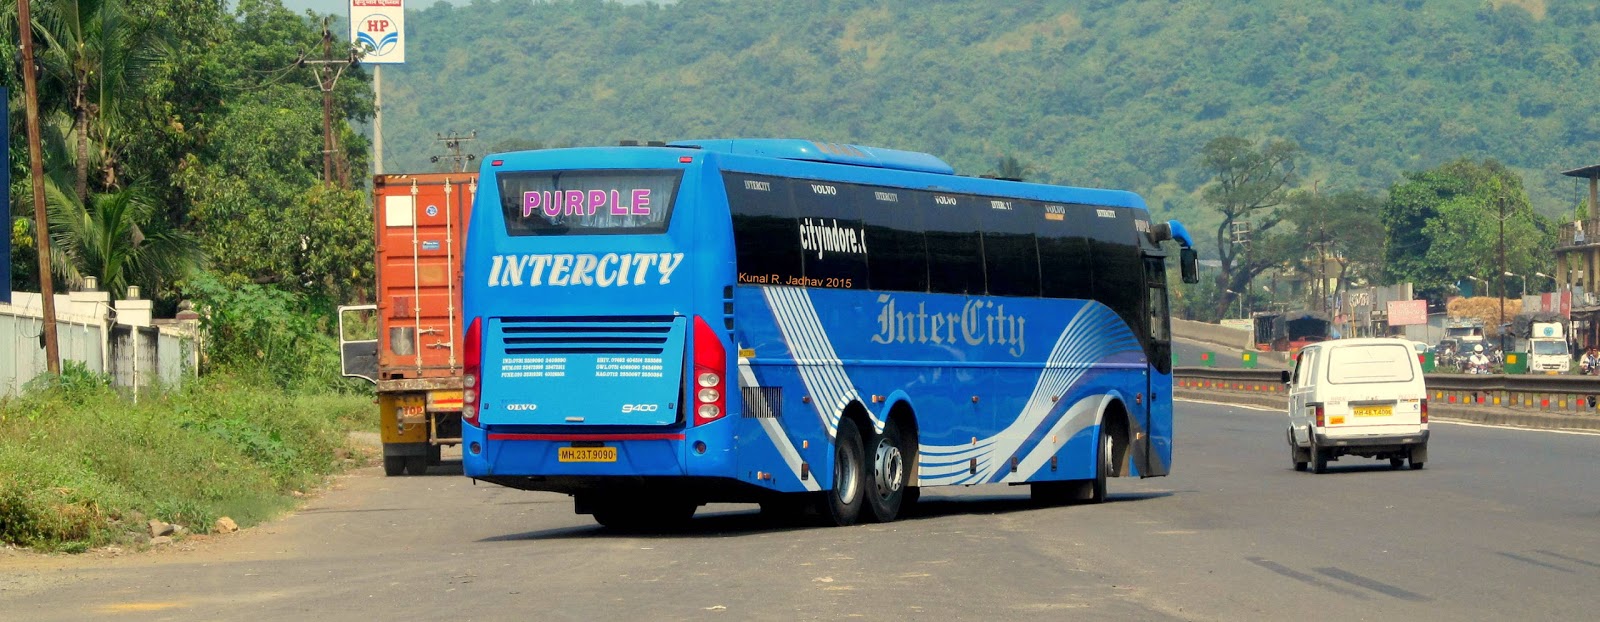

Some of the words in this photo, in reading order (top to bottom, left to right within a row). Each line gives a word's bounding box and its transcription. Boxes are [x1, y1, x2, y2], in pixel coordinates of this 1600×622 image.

[367, 20, 389, 32] HP
[744, 180, 771, 192] INTERCITY
[811, 184, 837, 195] VOLVO
[523, 189, 651, 217] PURPLE
[934, 195, 957, 206] VOLVO
[1045, 205, 1066, 214] VOLVO
[487, 252, 685, 288] INTERCITY
[871, 294, 1026, 358] InterCity
[621, 404, 658, 413] 9400
[561, 449, 614, 460] MH.23.T.9090
